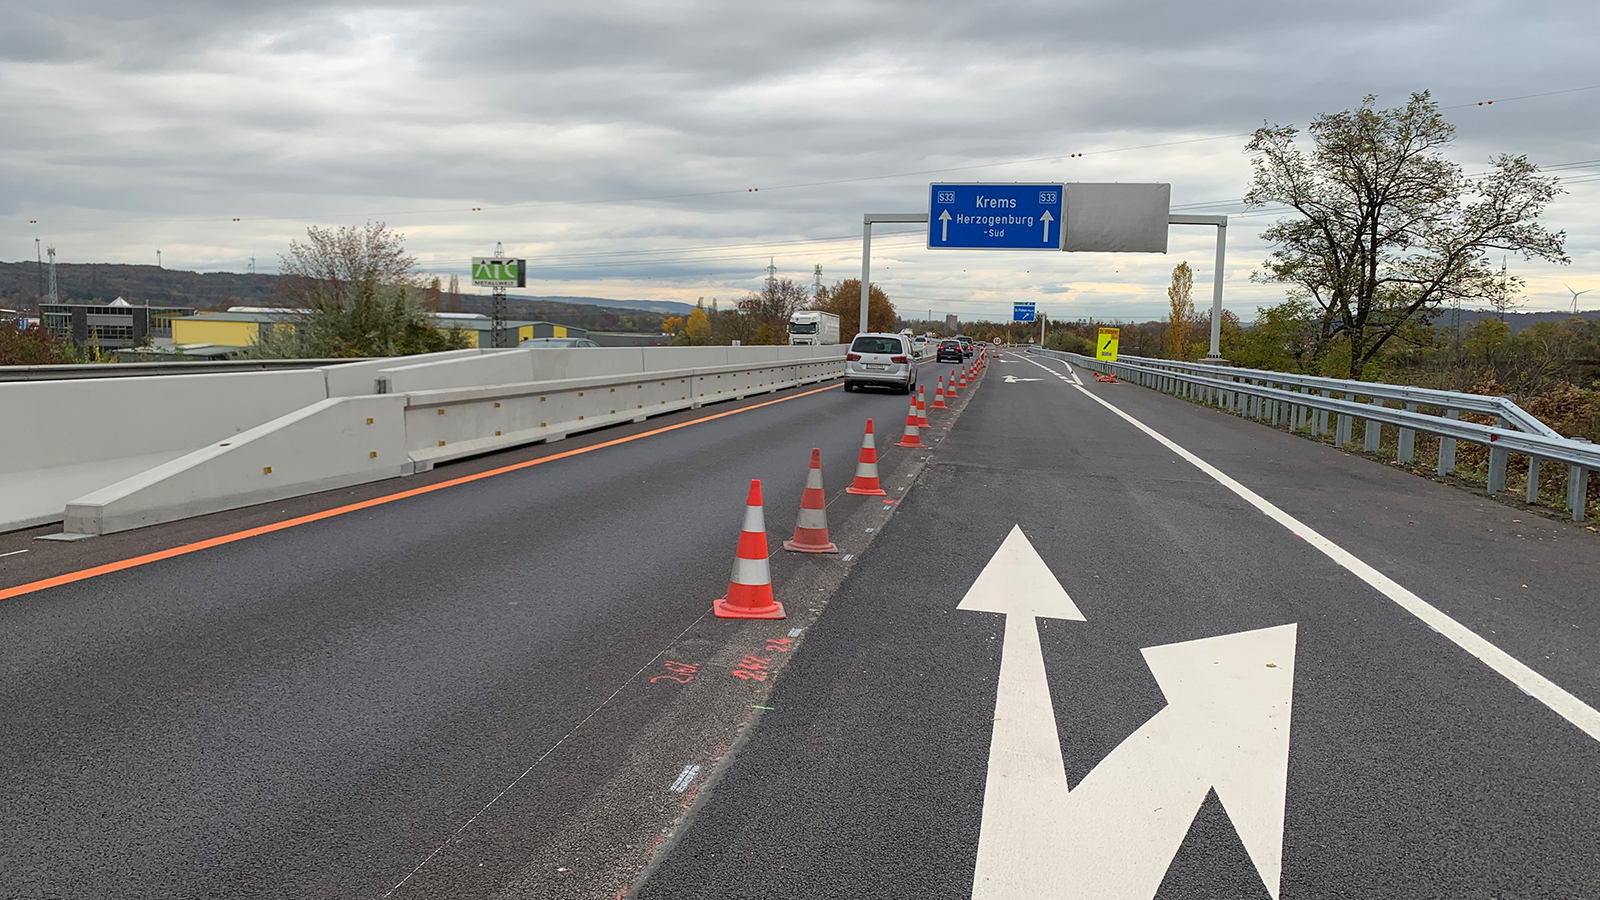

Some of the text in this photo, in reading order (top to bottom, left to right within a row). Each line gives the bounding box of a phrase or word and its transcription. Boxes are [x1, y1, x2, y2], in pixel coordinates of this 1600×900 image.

[938, 194, 954, 202] S33
[976, 195, 1017, 208] Krems
[1040, 194, 1056, 202] S33
[956, 214, 1034, 226] Herzogenburg
[983, 228, 1005, 237] -Süd
[475, 259, 515, 279] ATC
